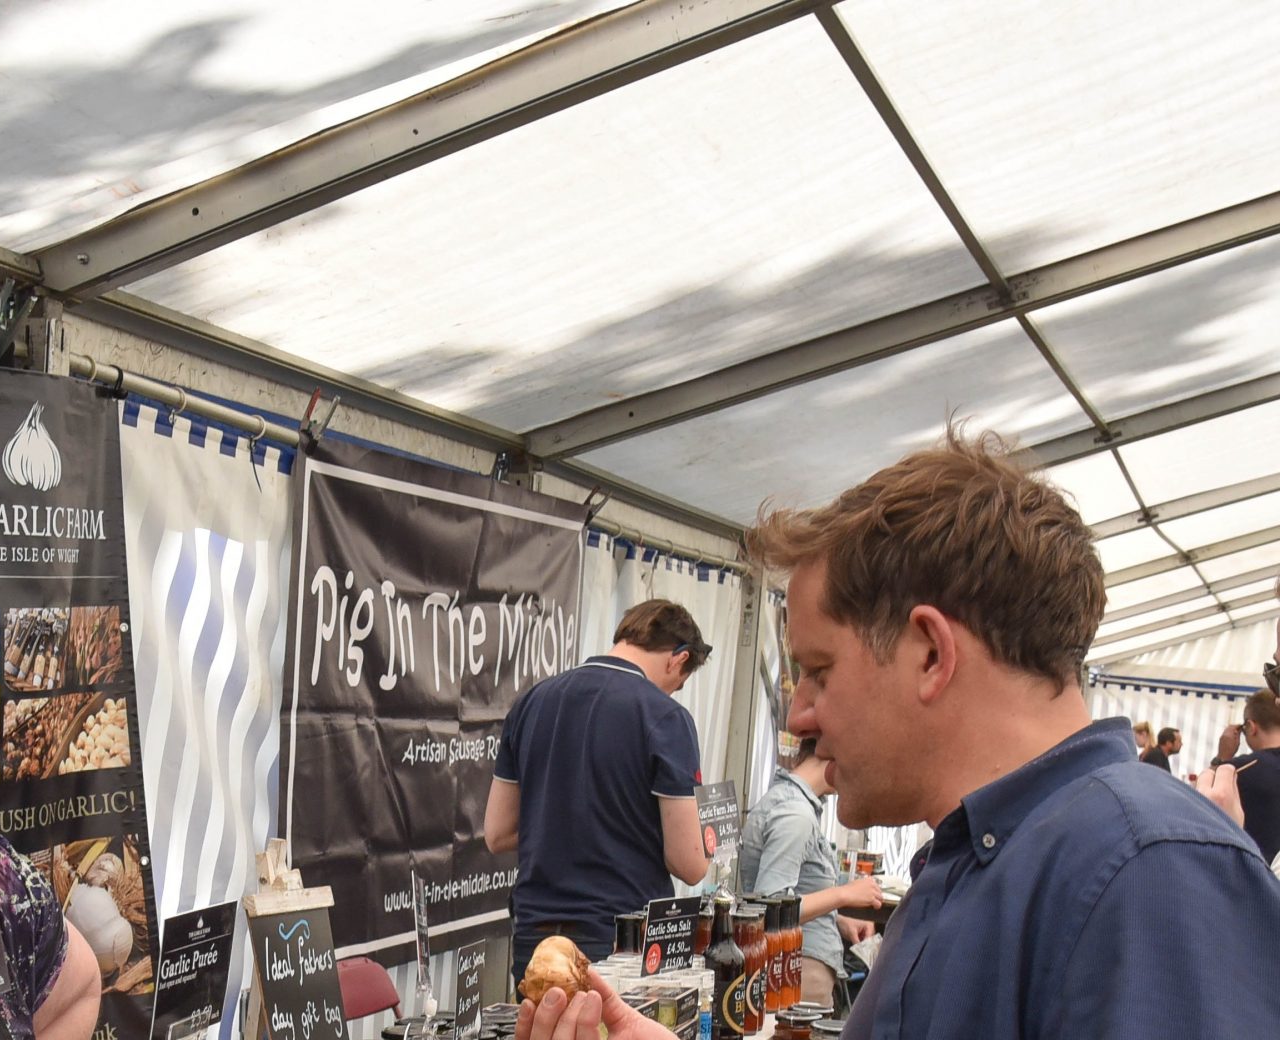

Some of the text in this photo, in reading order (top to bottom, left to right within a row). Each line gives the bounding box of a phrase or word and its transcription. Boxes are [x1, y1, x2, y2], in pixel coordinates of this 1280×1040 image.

[11, 547, 39, 563] ISLE
[42, 548, 55, 563] OF
[57, 548, 80, 564] WIGHT
[312, 566, 577, 692] Pig In The Middle
[402, 738, 484, 766] Artisan Sausage
[39, 803, 56, 825] ON
[56, 790, 136, 819] GARLIC!
[648, 923, 666, 936] Garlic
[667, 922, 677, 933] Sea
[679, 919, 691, 931] Salt
[161, 943, 218, 980] Garlic Purée
[266, 936, 332, 986] Ideal fathers
[667, 941, 684, 955] £4.50
[302, 1001, 319, 1040] gift
[324, 999, 343, 1038] bag
